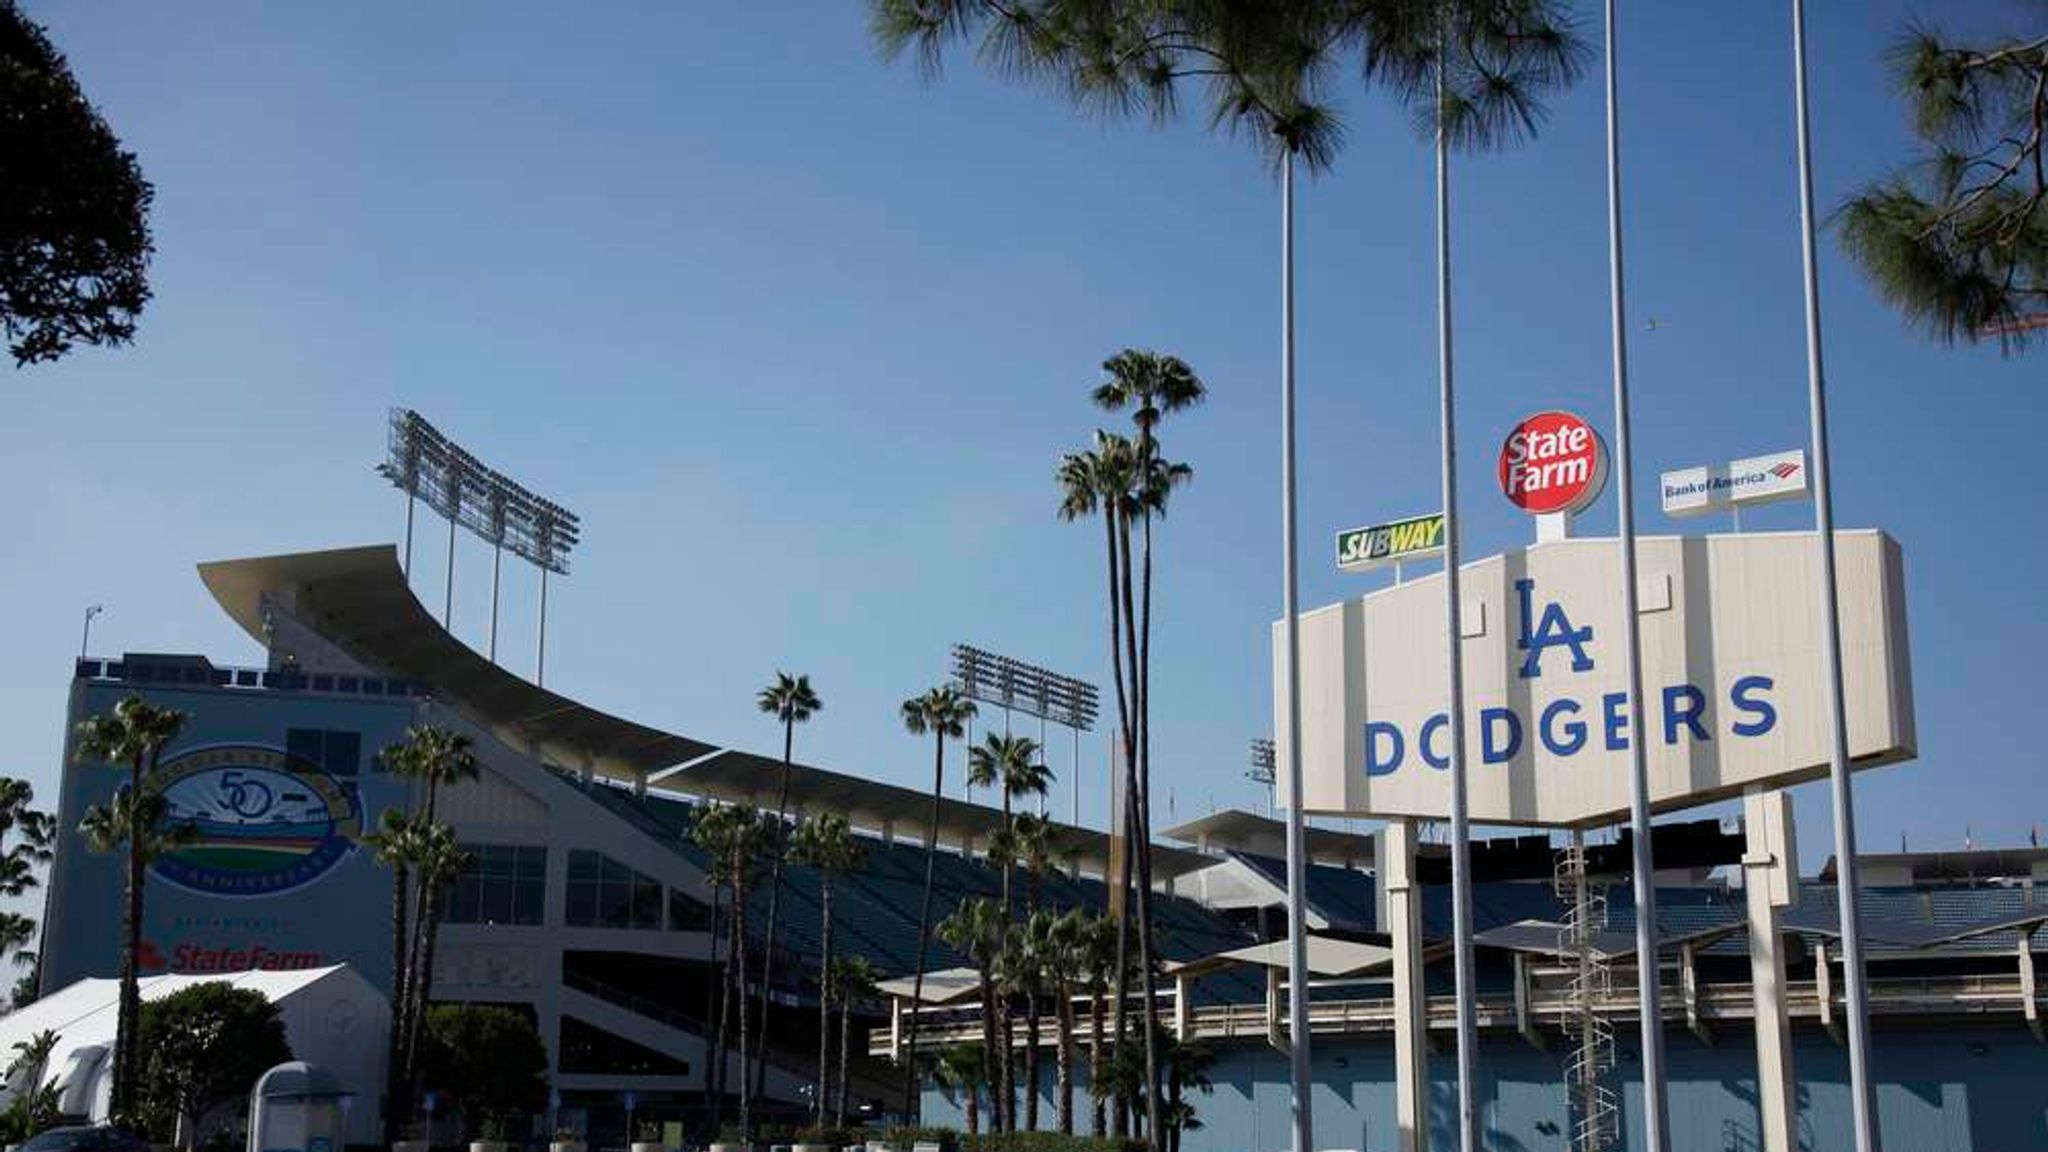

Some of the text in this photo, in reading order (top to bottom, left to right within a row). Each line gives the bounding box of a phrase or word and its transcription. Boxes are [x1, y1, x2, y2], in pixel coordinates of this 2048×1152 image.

[1508, 425, 1587, 464] State
[1508, 455, 1588, 495] Farm
[1665, 472, 1766, 499] Bank of America
[1341, 518, 1443, 563] SUBWAY
[1515, 579, 1594, 679] LA
[1364, 675, 1778, 777] DODGERS
[217, 772, 272, 818] 50
